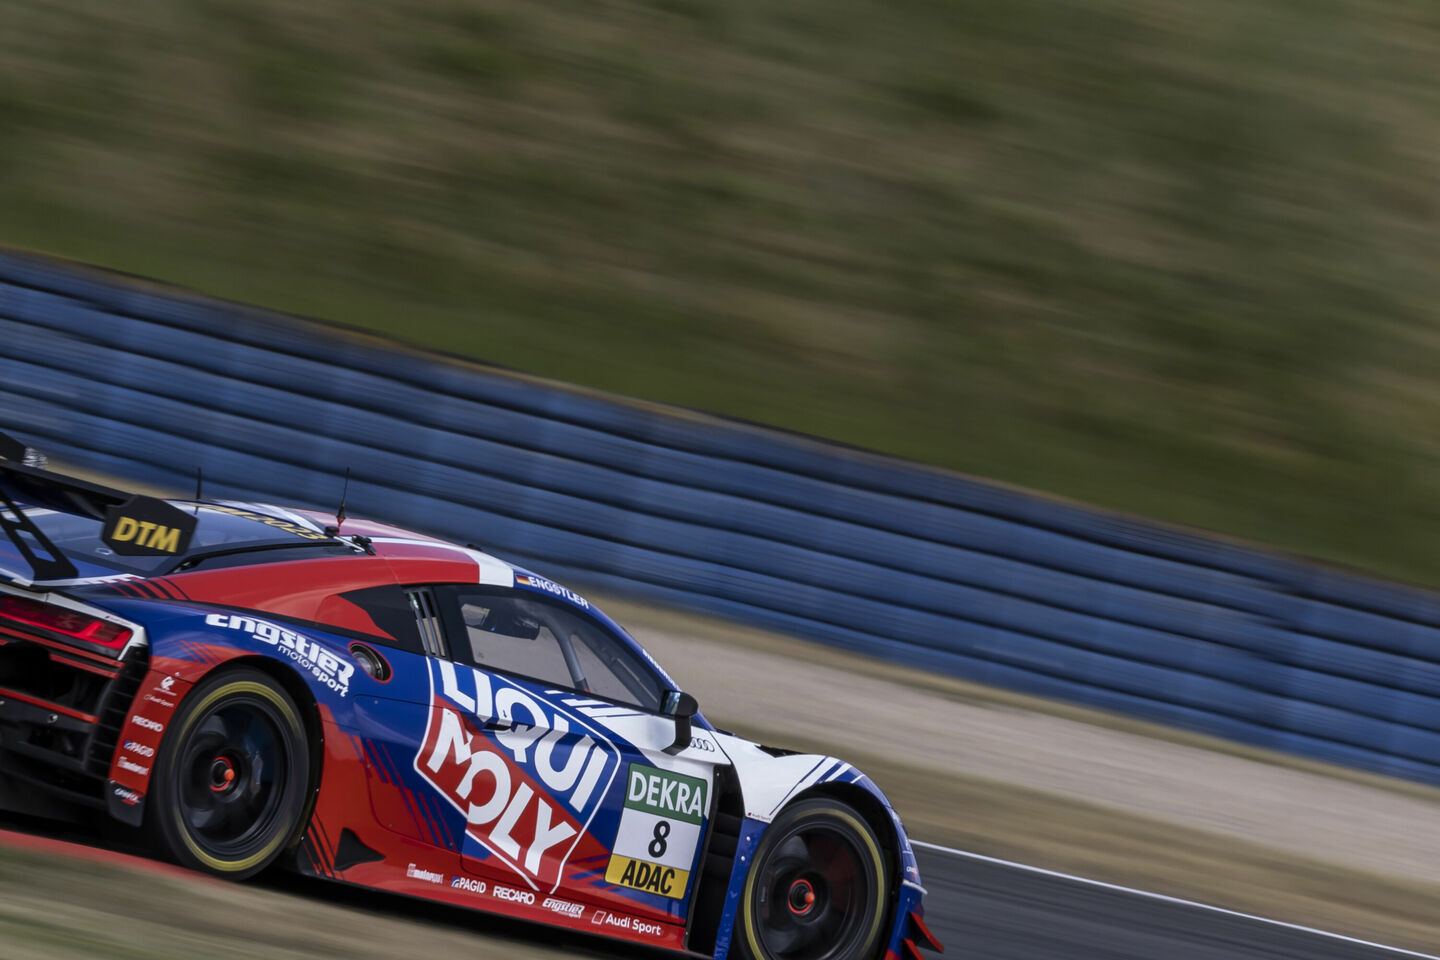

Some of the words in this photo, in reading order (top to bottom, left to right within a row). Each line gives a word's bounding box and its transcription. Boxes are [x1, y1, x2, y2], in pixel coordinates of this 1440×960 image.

[112, 516, 181, 553] DTM
[529, 576, 589, 609] ENGSTLER
[277, 645, 349, 698] motorsport
[438, 660, 609, 813] LIQUI
[426, 707, 577, 877] MOLY
[628, 771, 703, 817] DEKRA
[648, 820, 671, 858] 8
[459, 877, 487, 893] PAGID
[620, 859, 675, 894] ADAC
[493, 886, 535, 905] RECARO
[606, 913, 630, 928] Audi
[632, 919, 661, 935] Sport
